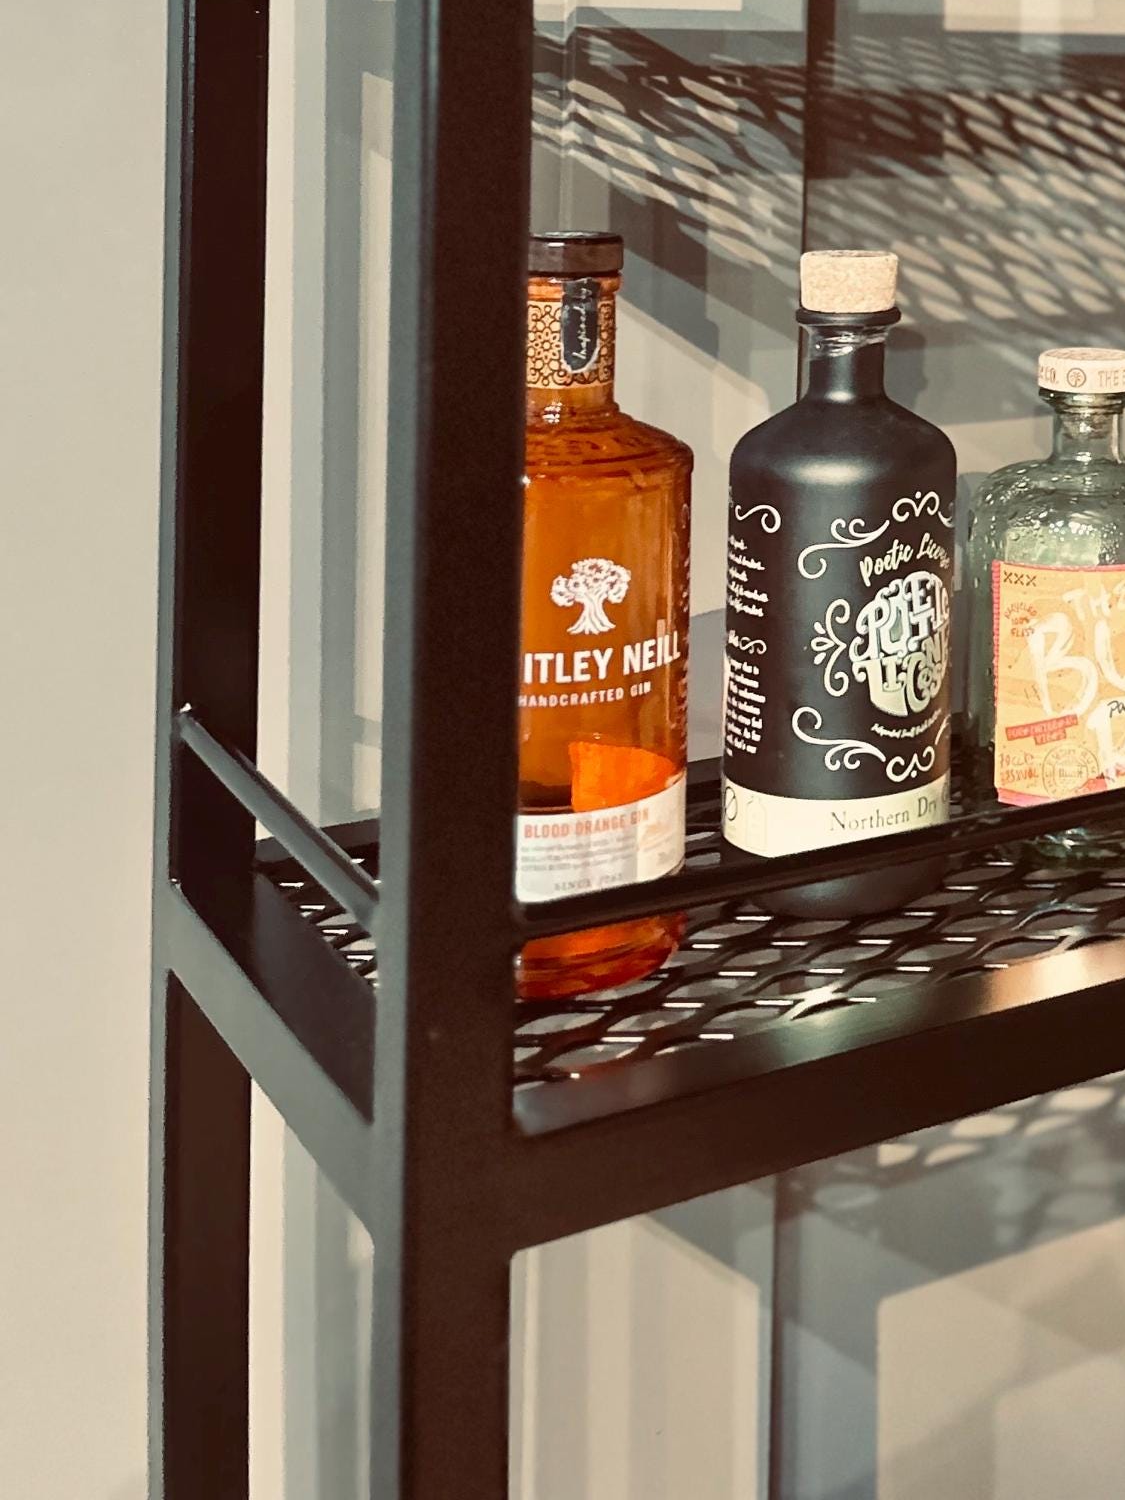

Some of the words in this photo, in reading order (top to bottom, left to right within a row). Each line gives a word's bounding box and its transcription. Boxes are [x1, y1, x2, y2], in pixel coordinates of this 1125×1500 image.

[859, 538, 914, 588] Poetic
[1003, 570, 1037, 588] XXX
[623, 630, 681, 676] NEILL
[518, 687, 624, 708] HANDCRAFTED
[630, 681, 652, 697] GIN
[524, 823, 570, 839] BLOOD
[575, 813, 626, 837] ORANGE
[830, 808, 910, 832] Northern
